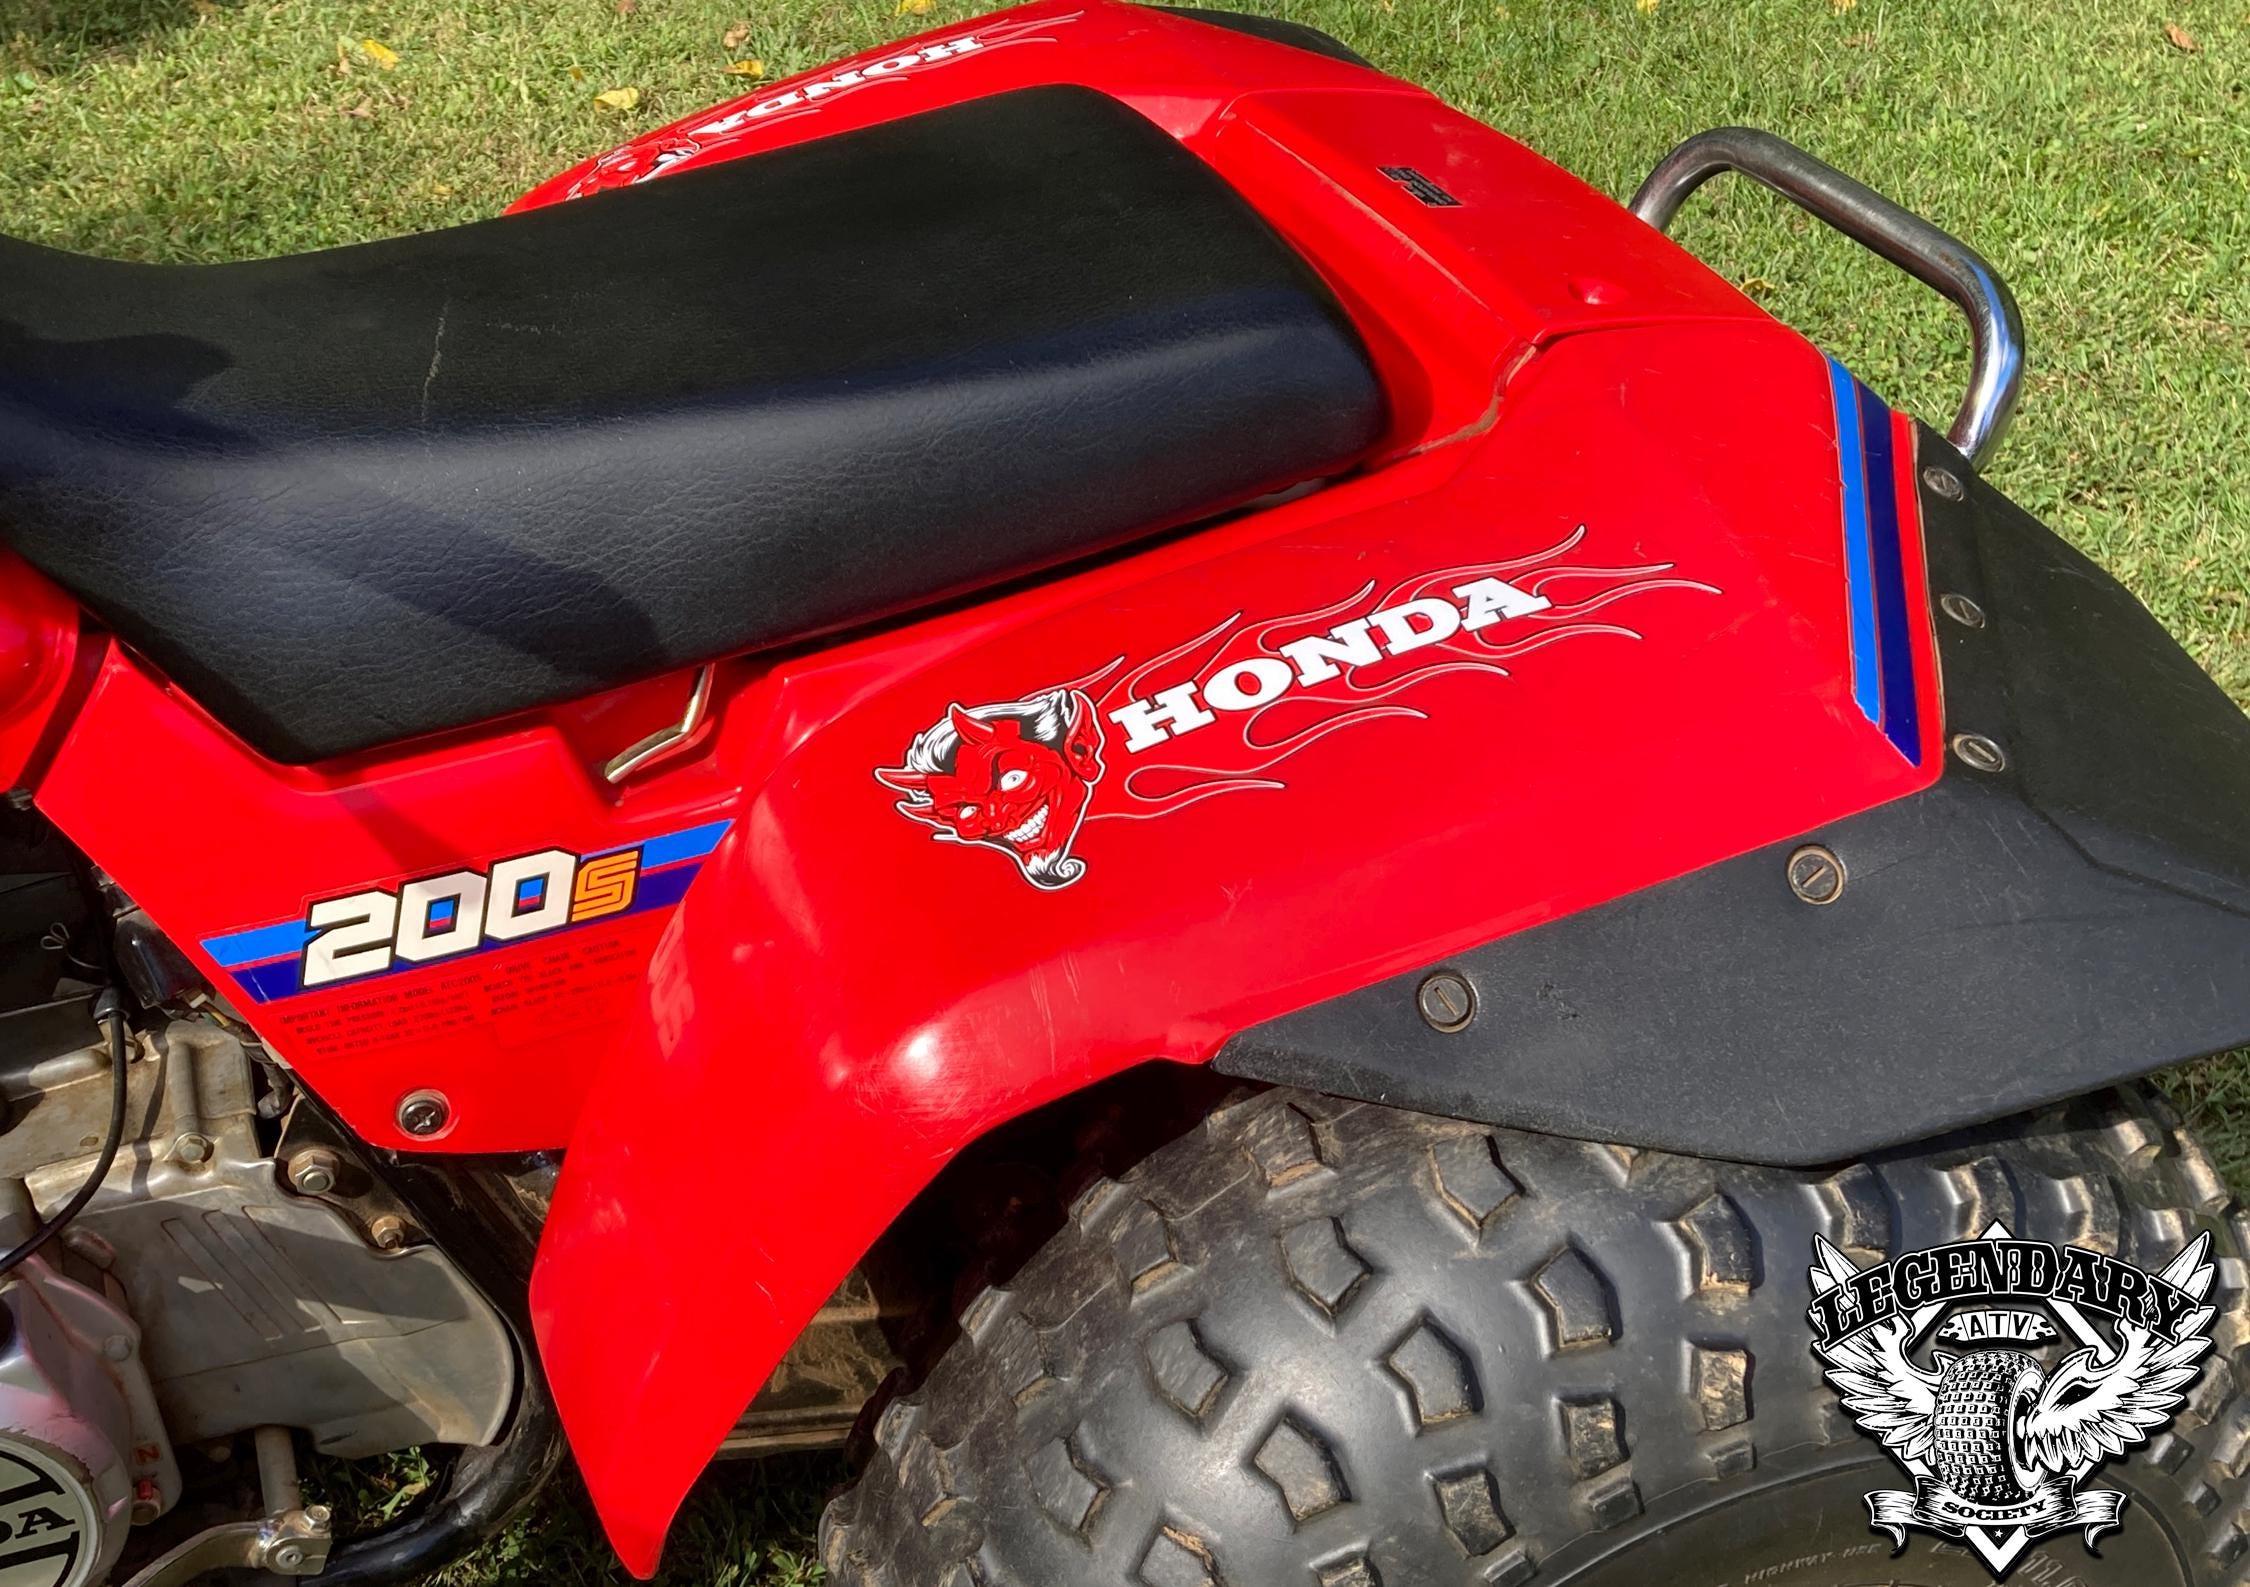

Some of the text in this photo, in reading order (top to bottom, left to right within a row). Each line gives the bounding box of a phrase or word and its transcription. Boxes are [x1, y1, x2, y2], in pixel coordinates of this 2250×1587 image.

[687, 37, 984, 135] HONDA
[1109, 577, 1552, 754] HONDA
[301, 847, 643, 988] 200S
